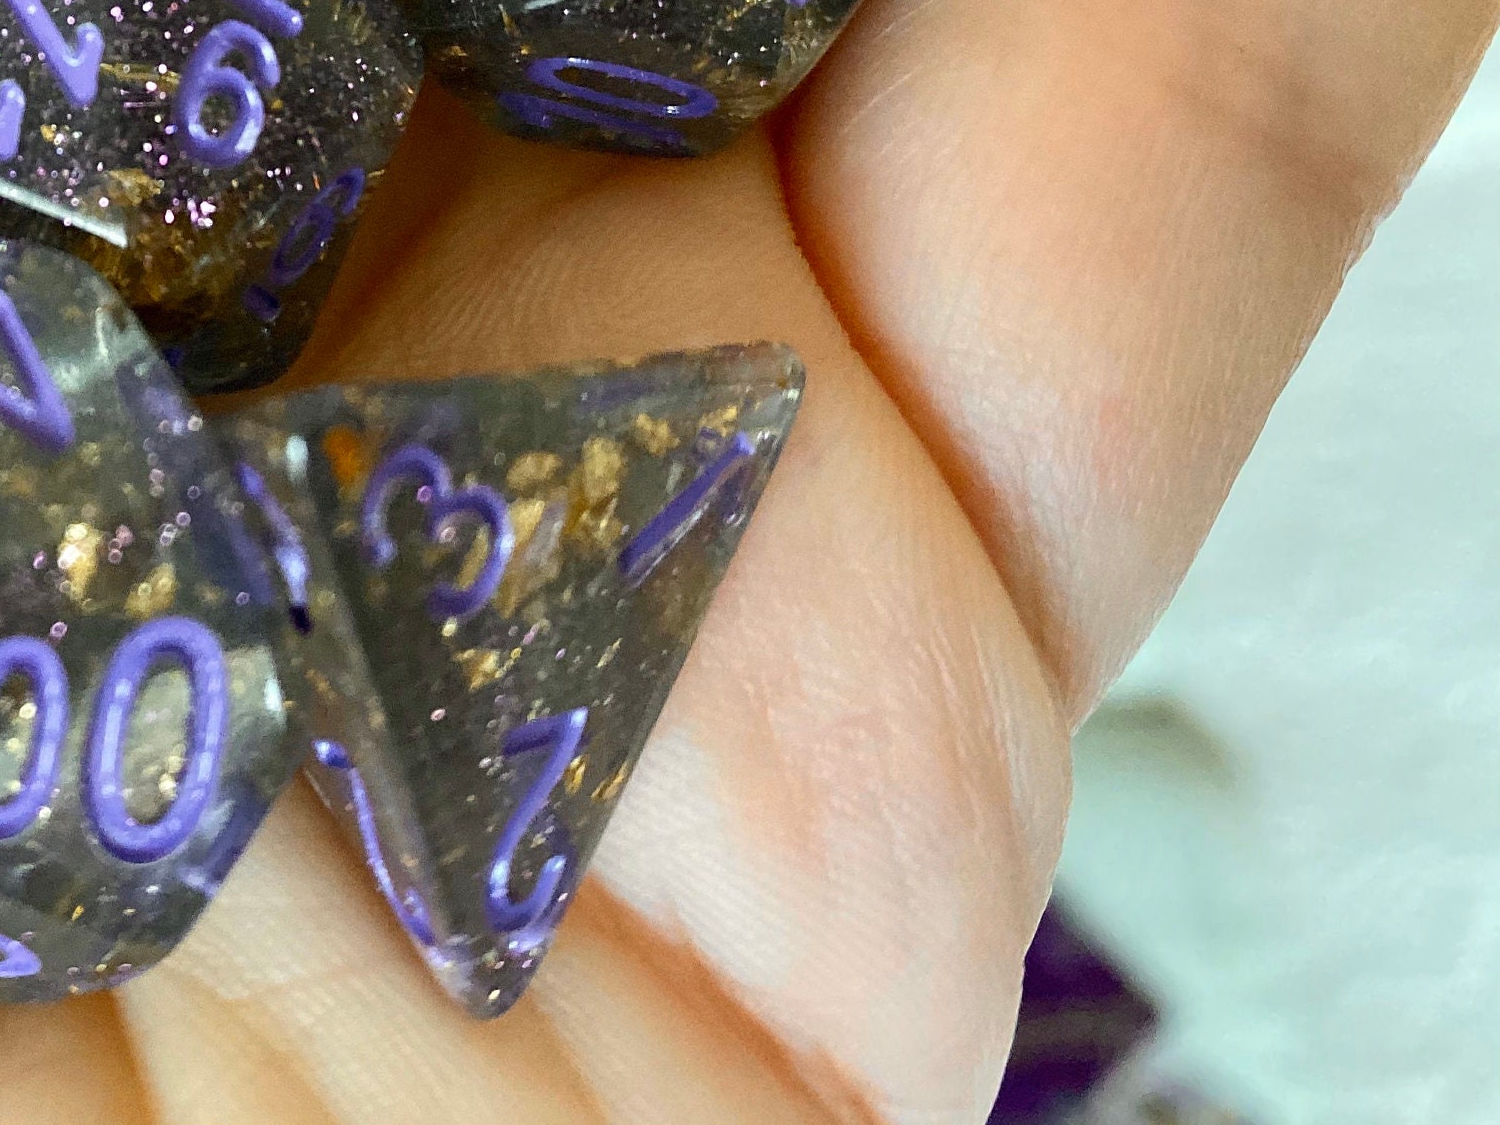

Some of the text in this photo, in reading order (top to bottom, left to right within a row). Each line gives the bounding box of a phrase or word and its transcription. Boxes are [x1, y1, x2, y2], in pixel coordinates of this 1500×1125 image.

[501, 56, 720, 149] 10
[360, 442, 515, 622] 3
[483, 706, 589, 933] 2
